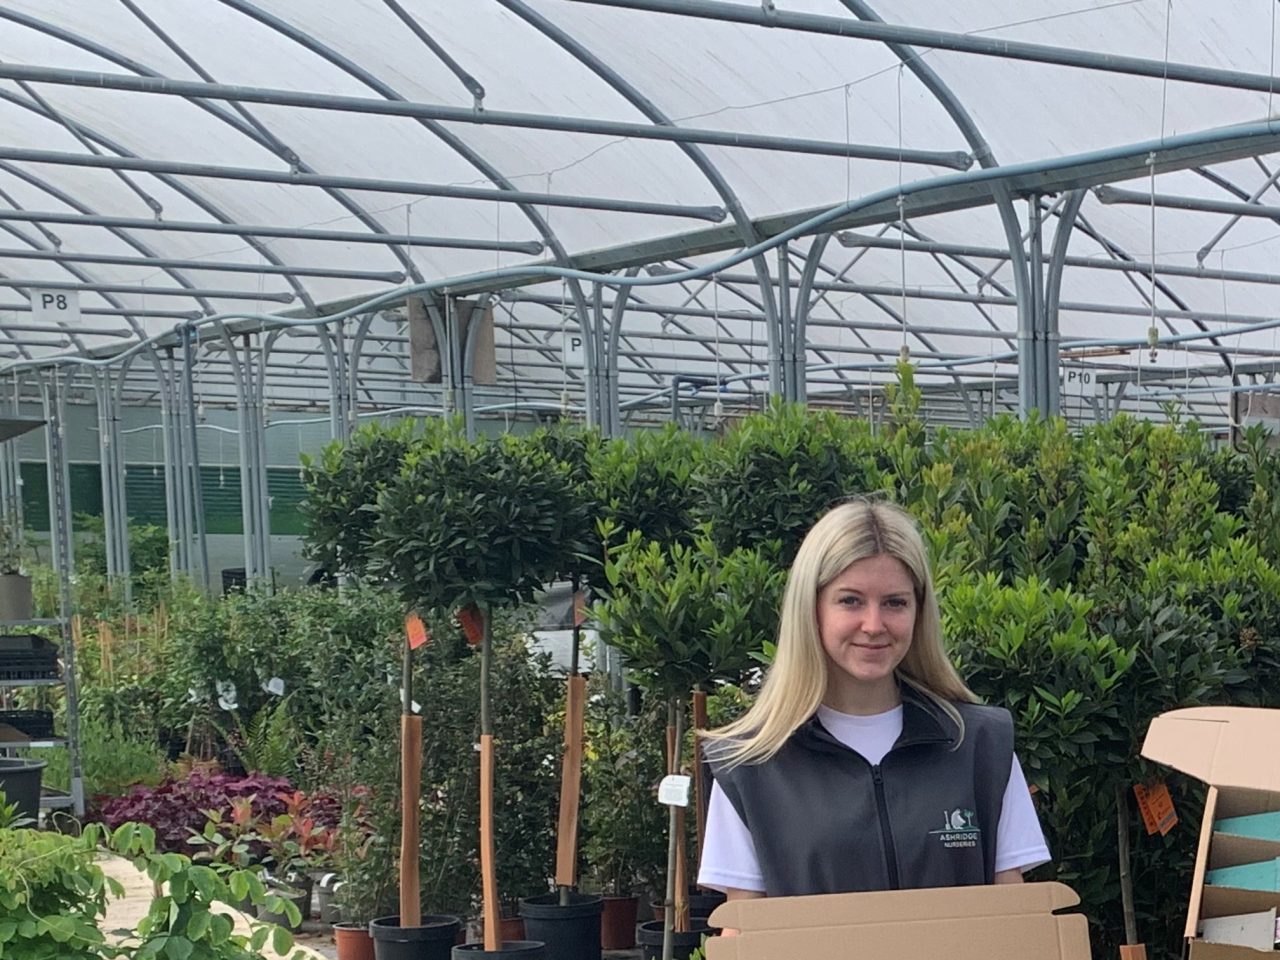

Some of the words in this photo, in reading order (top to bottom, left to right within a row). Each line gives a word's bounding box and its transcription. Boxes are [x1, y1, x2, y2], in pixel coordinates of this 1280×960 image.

[42, 293, 68, 310] P8
[571, 338, 582, 352] P
[1068, 371, 1091, 385] P10
[940, 832, 978, 841] ASHRIDGE
